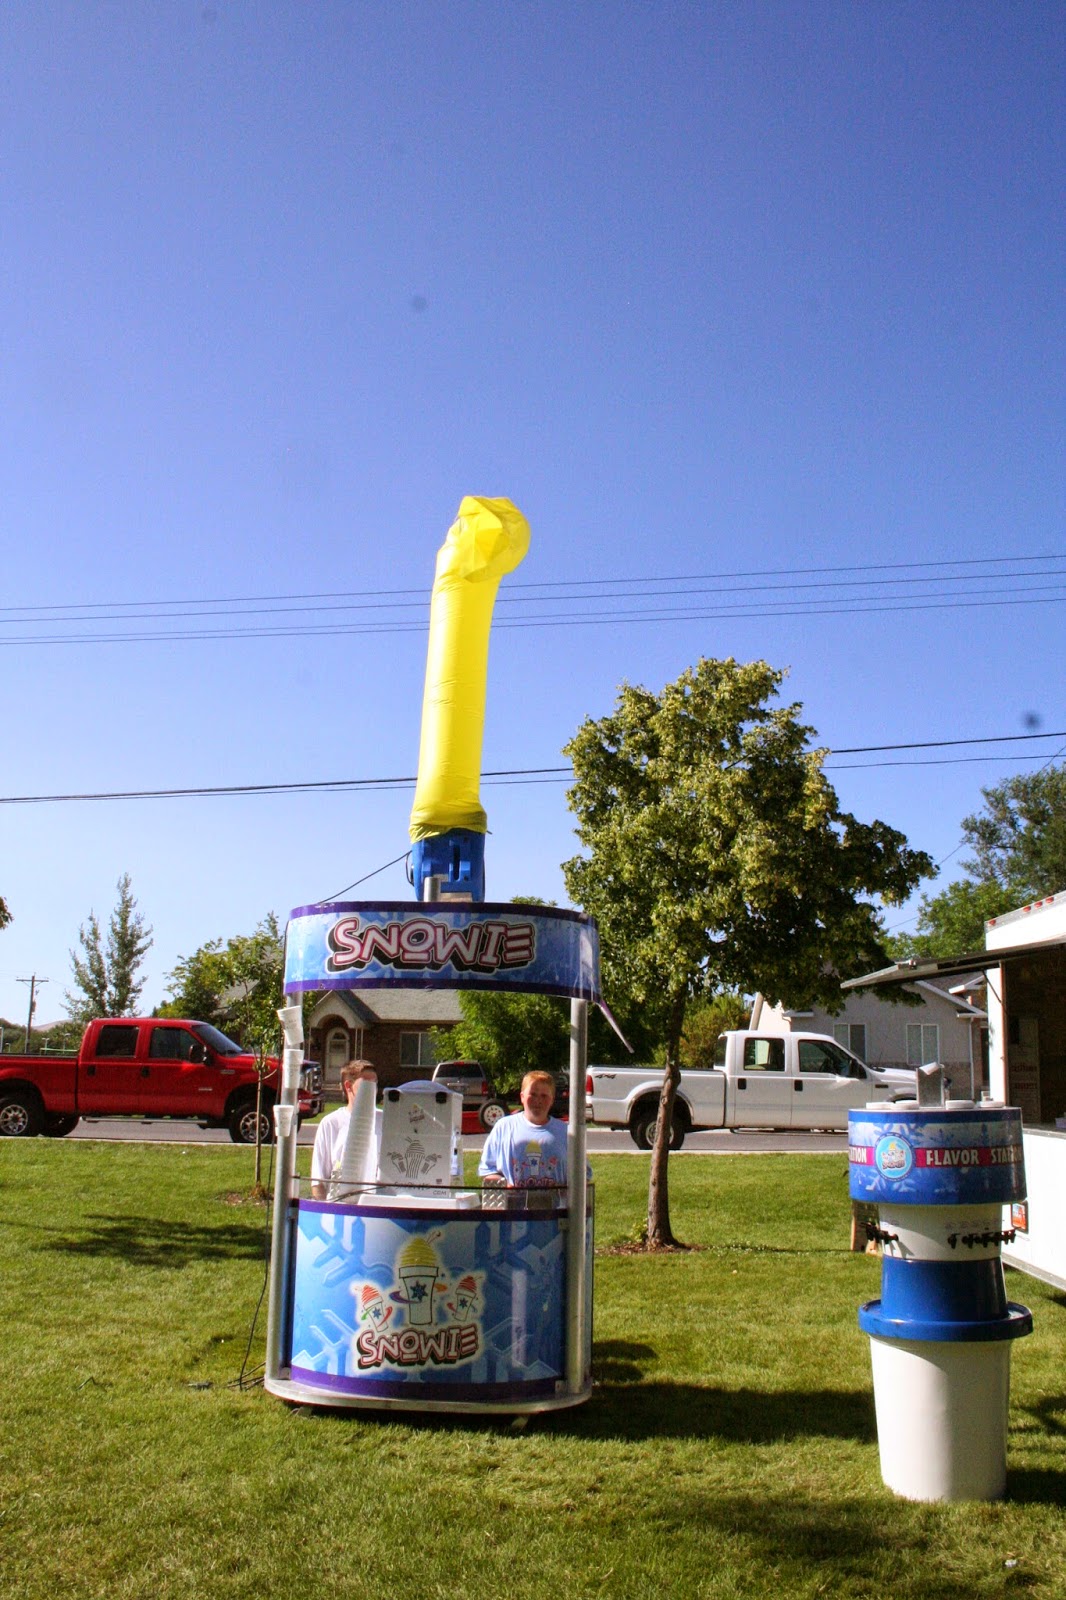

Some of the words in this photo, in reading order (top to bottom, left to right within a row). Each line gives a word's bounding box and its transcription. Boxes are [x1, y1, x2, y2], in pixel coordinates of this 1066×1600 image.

[329, 917, 534, 973] SNOWIE
[926, 1149, 980, 1166] FLAVOR
[357, 1322, 479, 1369] SNOWIE
